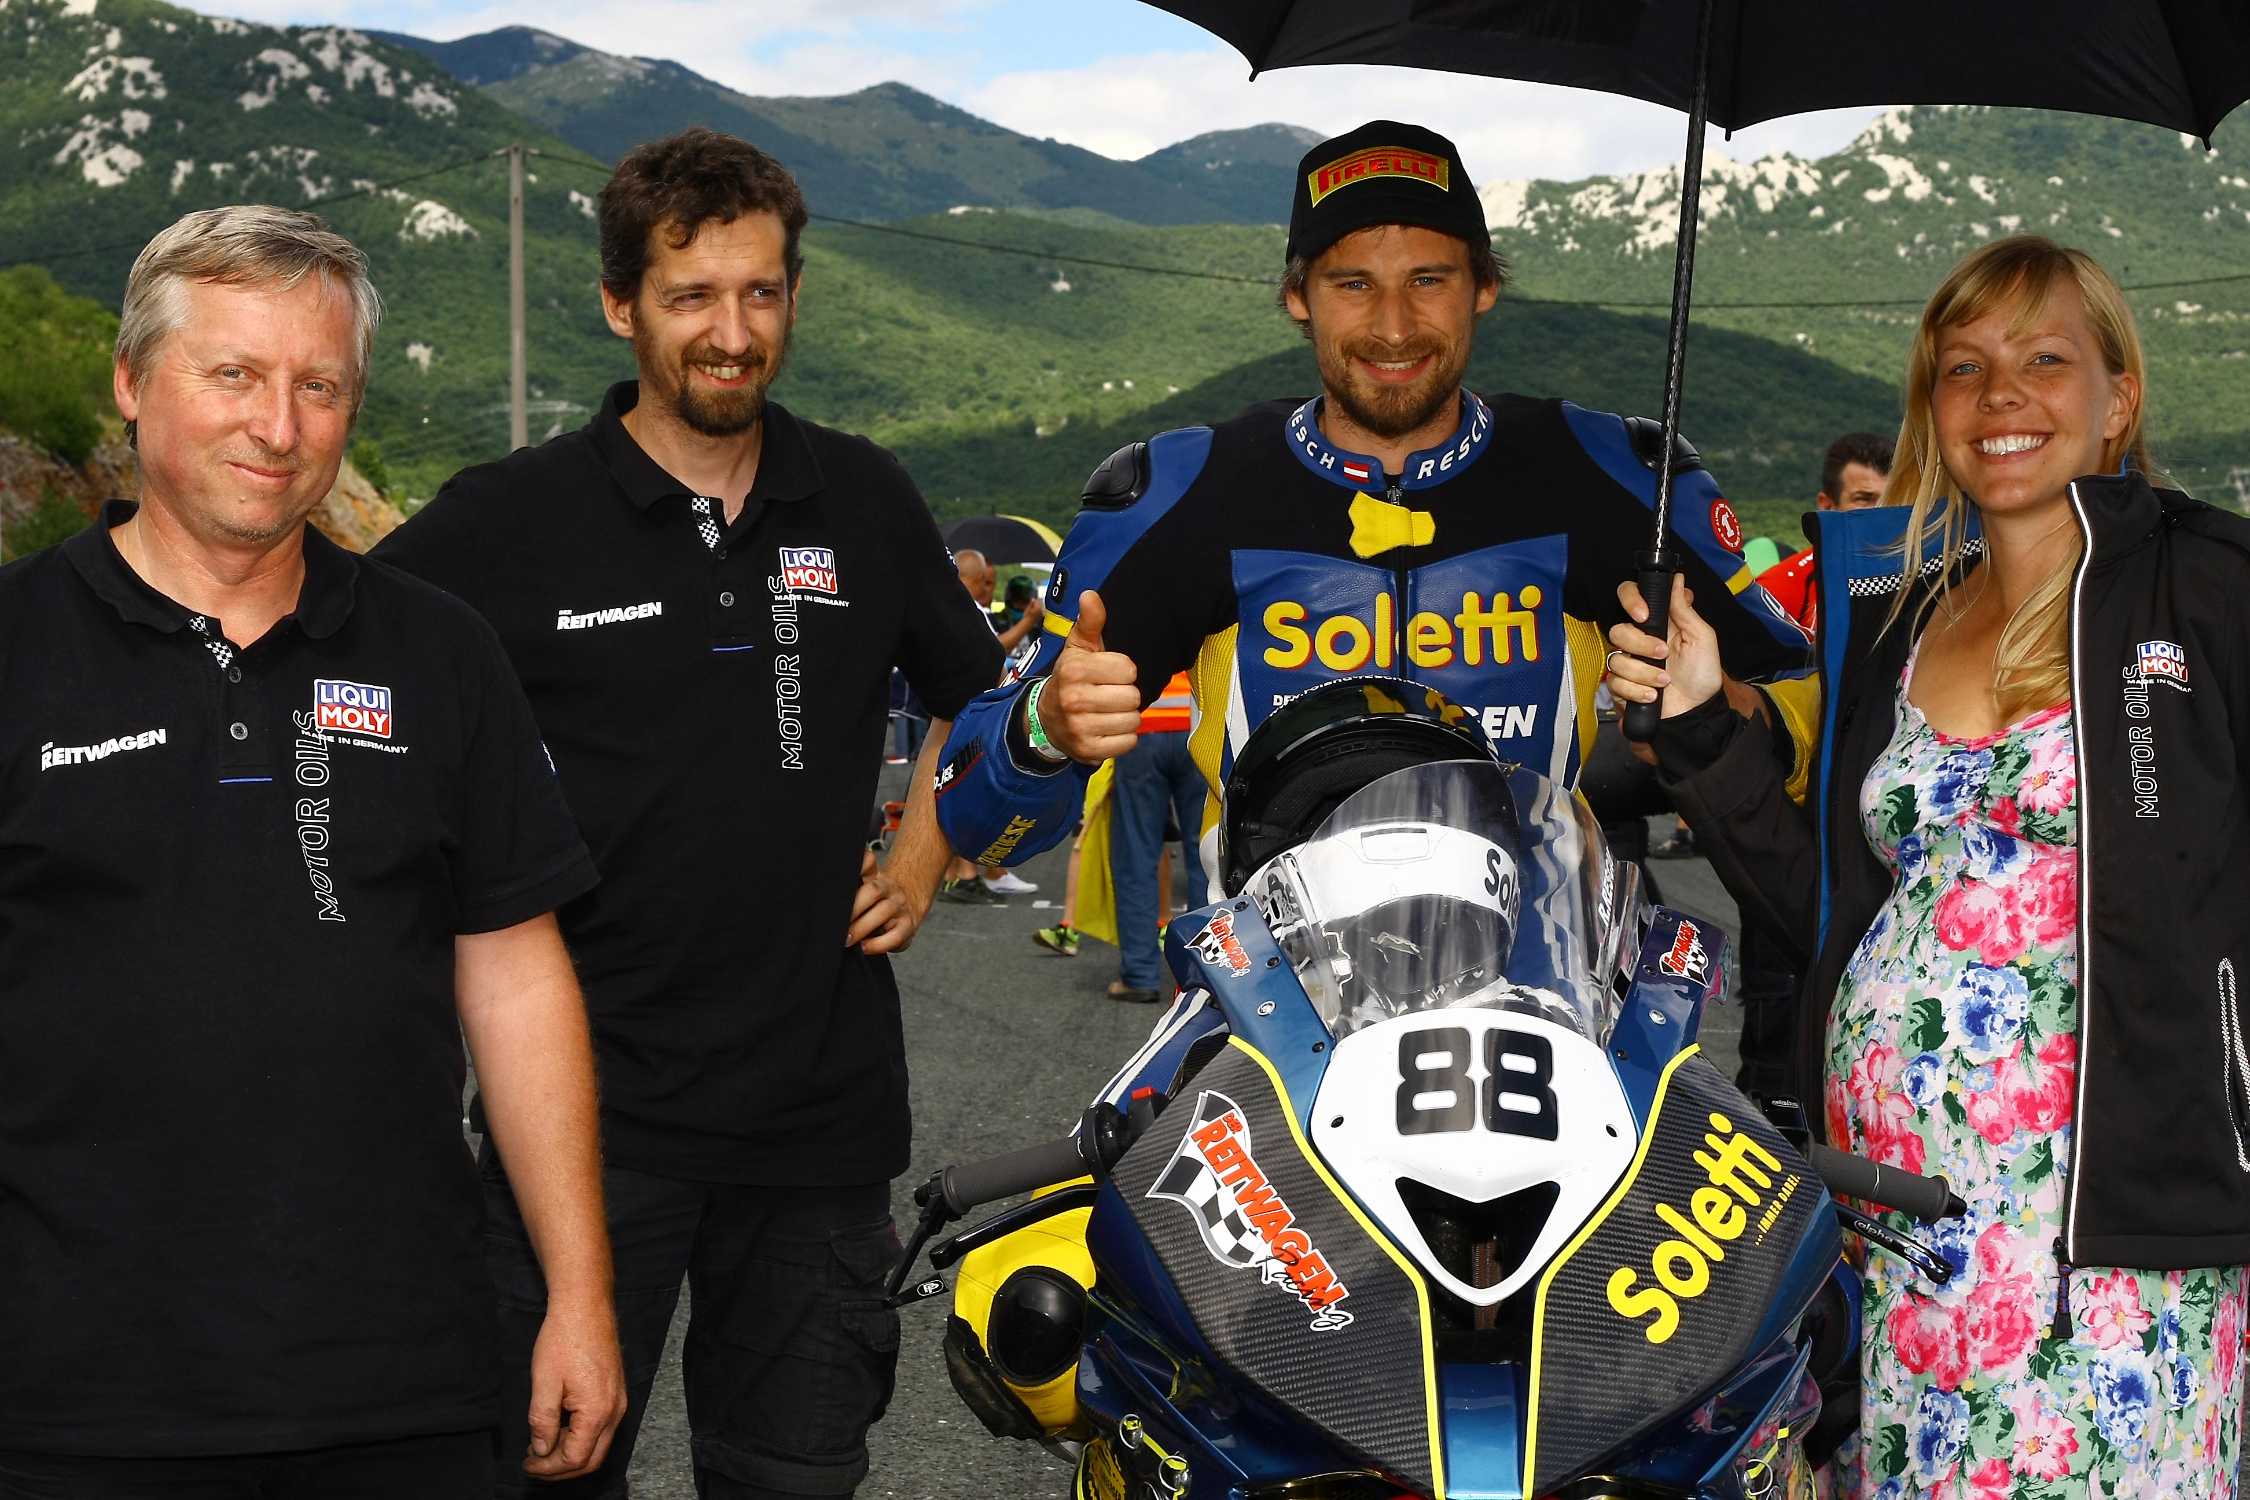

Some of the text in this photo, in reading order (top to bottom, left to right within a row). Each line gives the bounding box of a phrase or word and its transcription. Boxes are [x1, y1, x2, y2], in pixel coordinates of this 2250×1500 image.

[1317, 148, 1438, 194] PIRELLI
[1416, 410, 1489, 480] RESCH
[783, 550, 832, 569] LIQUI
[786, 568, 834, 590] MOLY
[556, 601, 662, 630] REITWAGEN
[803, 594, 813, 602] IN
[813, 596, 850, 608] GERMANY
[1262, 584, 1544, 671] Soletti
[767, 575, 804, 771] MOTOR OILS
[2141, 643, 2185, 664] LIQUI
[2142, 658, 2187, 679] MOLY
[320, 684, 387, 710] LIQUI
[320, 704, 389, 733] MOLY
[41, 728, 167, 772] REITWAGEN
[301, 729, 409, 754] MADE IN GERMANY
[2122, 663, 2160, 818] MOTOR OILS
[293, 709, 346, 922] MOTOR OILS
[1395, 1026, 1559, 1142] 88
[1190, 1119, 1346, 1312] REITWAGEN
[1606, 1112, 1782, 1344] Soletti
[1856, 1220, 1894, 1243] alpha
[1255, 1248, 1352, 1329] Racing
